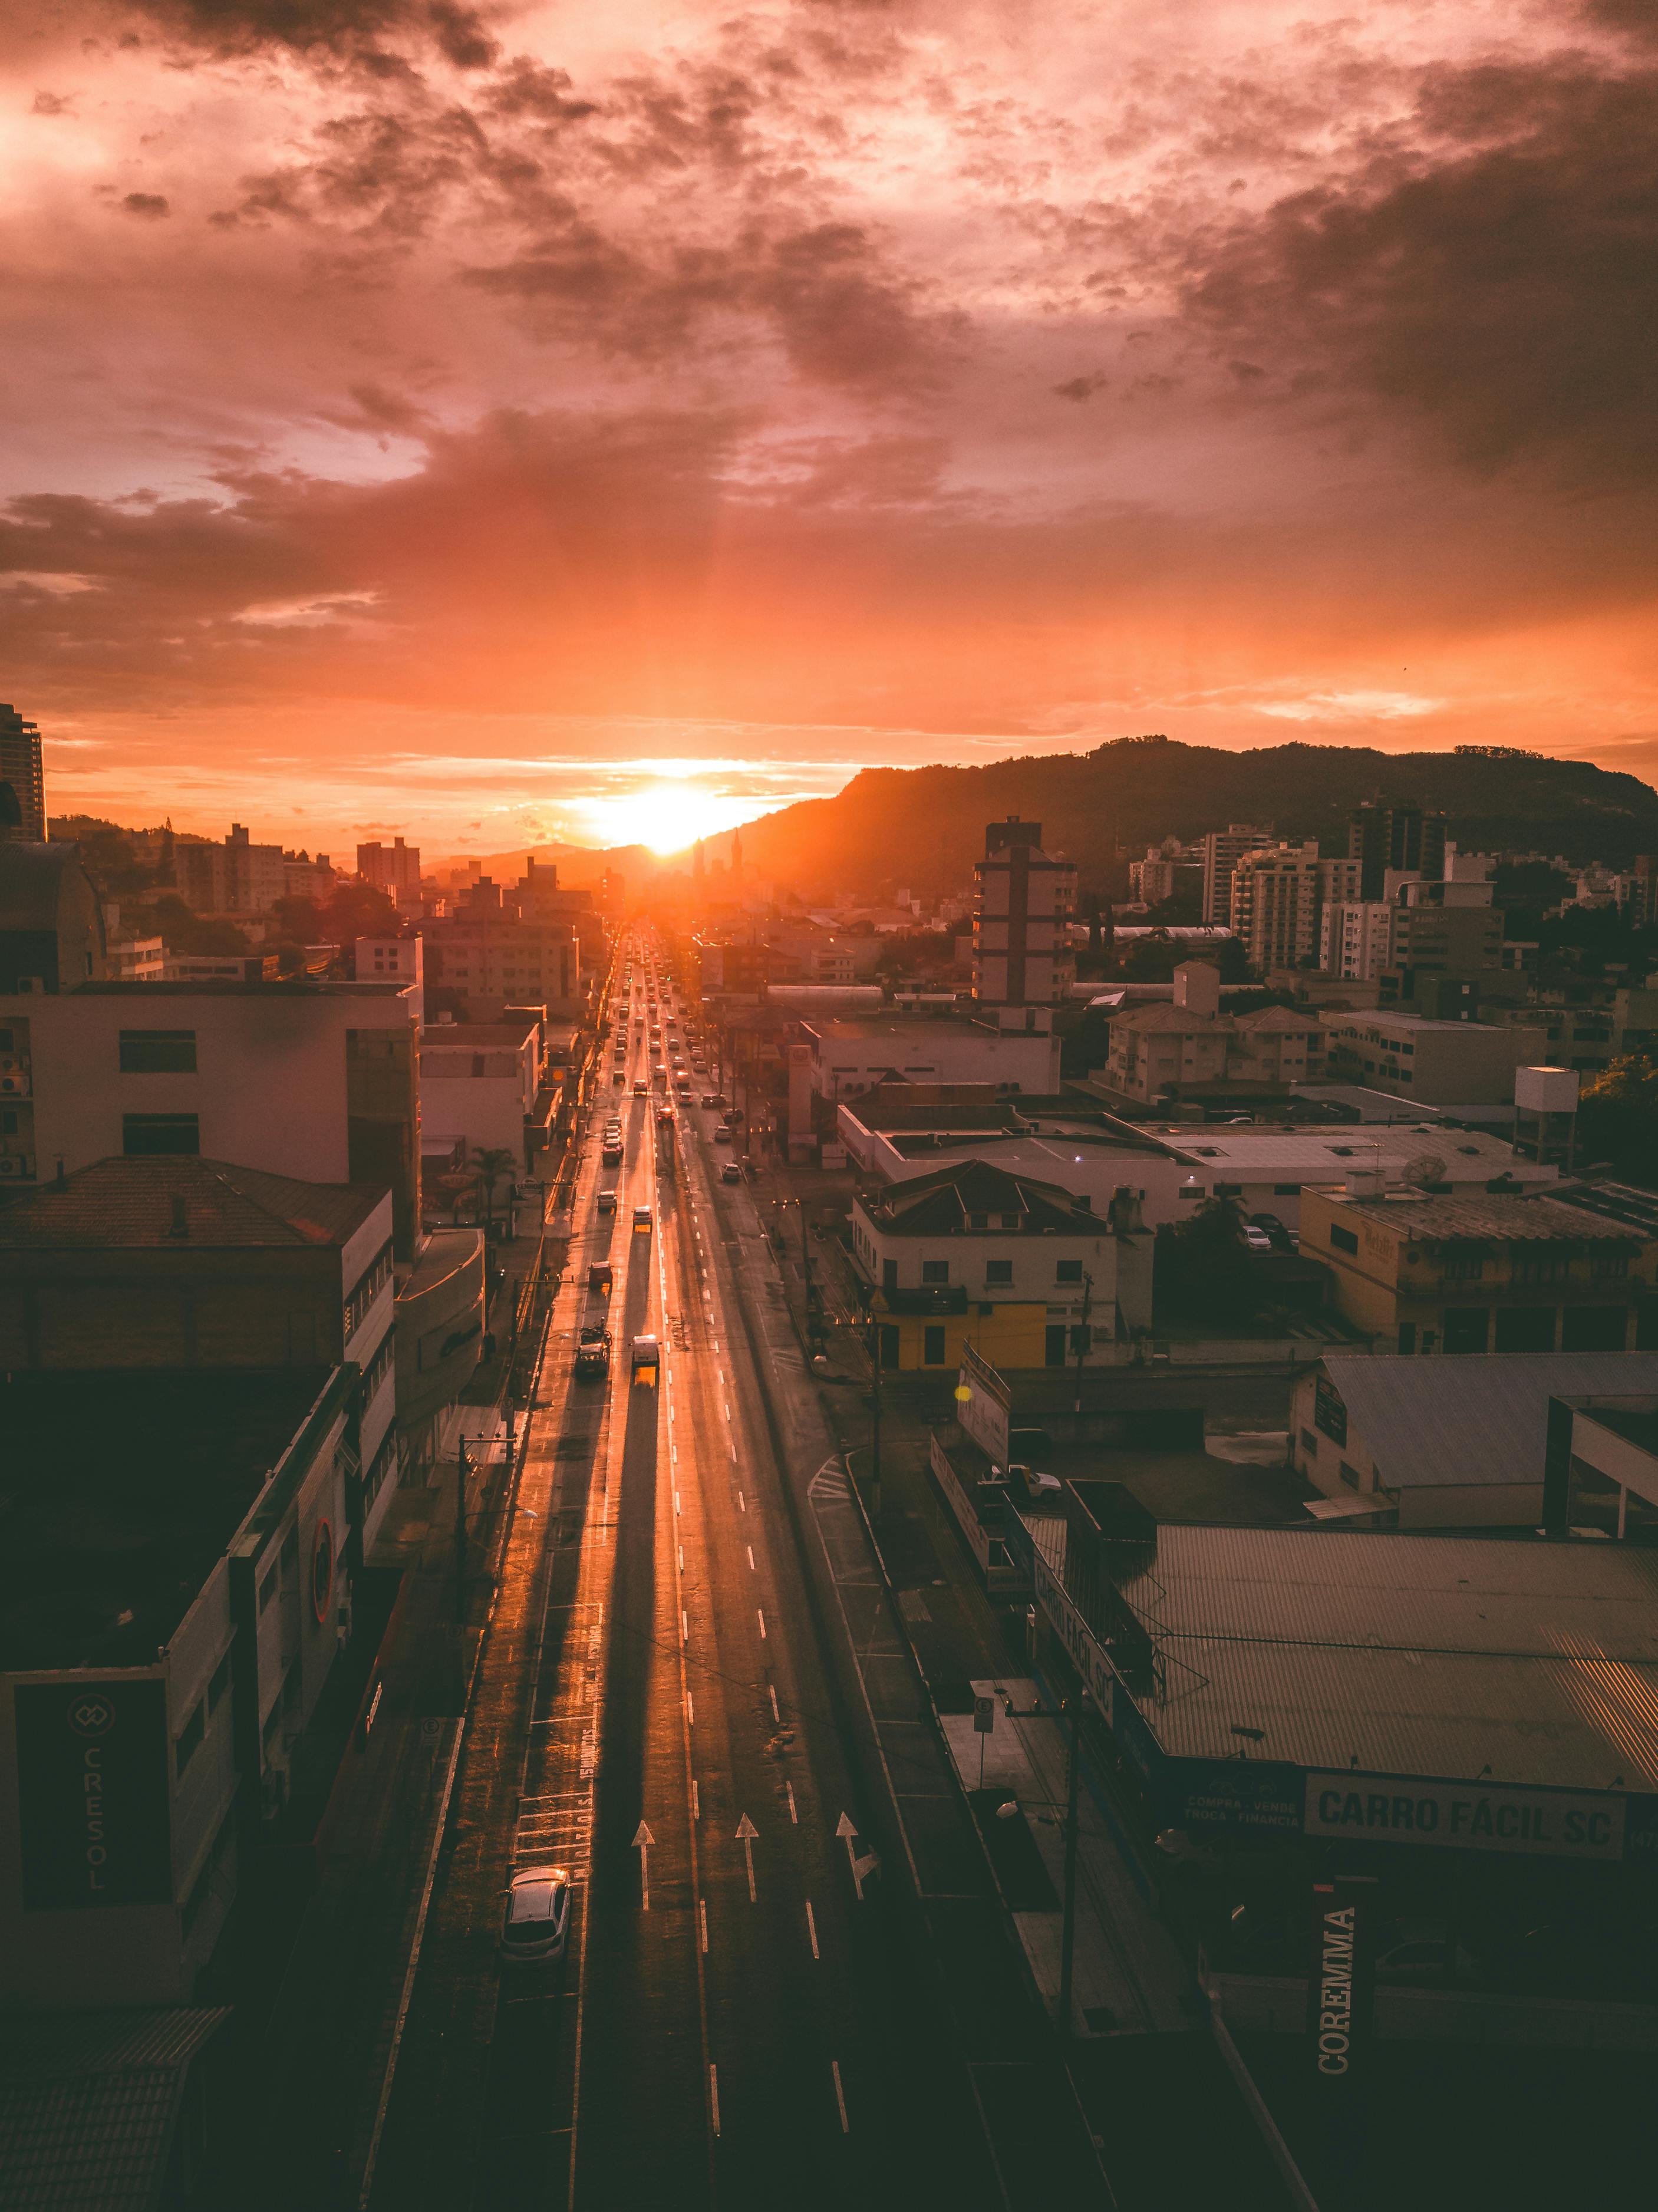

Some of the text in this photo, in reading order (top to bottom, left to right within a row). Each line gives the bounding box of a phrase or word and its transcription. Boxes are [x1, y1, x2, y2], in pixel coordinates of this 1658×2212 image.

[428, 1721, 434, 1731] E
[84, 1748, 106, 1889] CRESOL
[1184, 1808, 1298, 1827] TROCA FINANCIA
[1188, 1796, 1297, 1814] COMPRA VENDE
[1319, 1790, 1611, 1845] CARRO FÁCIL SC
[1317, 1906, 1355, 2075] COREMMA
